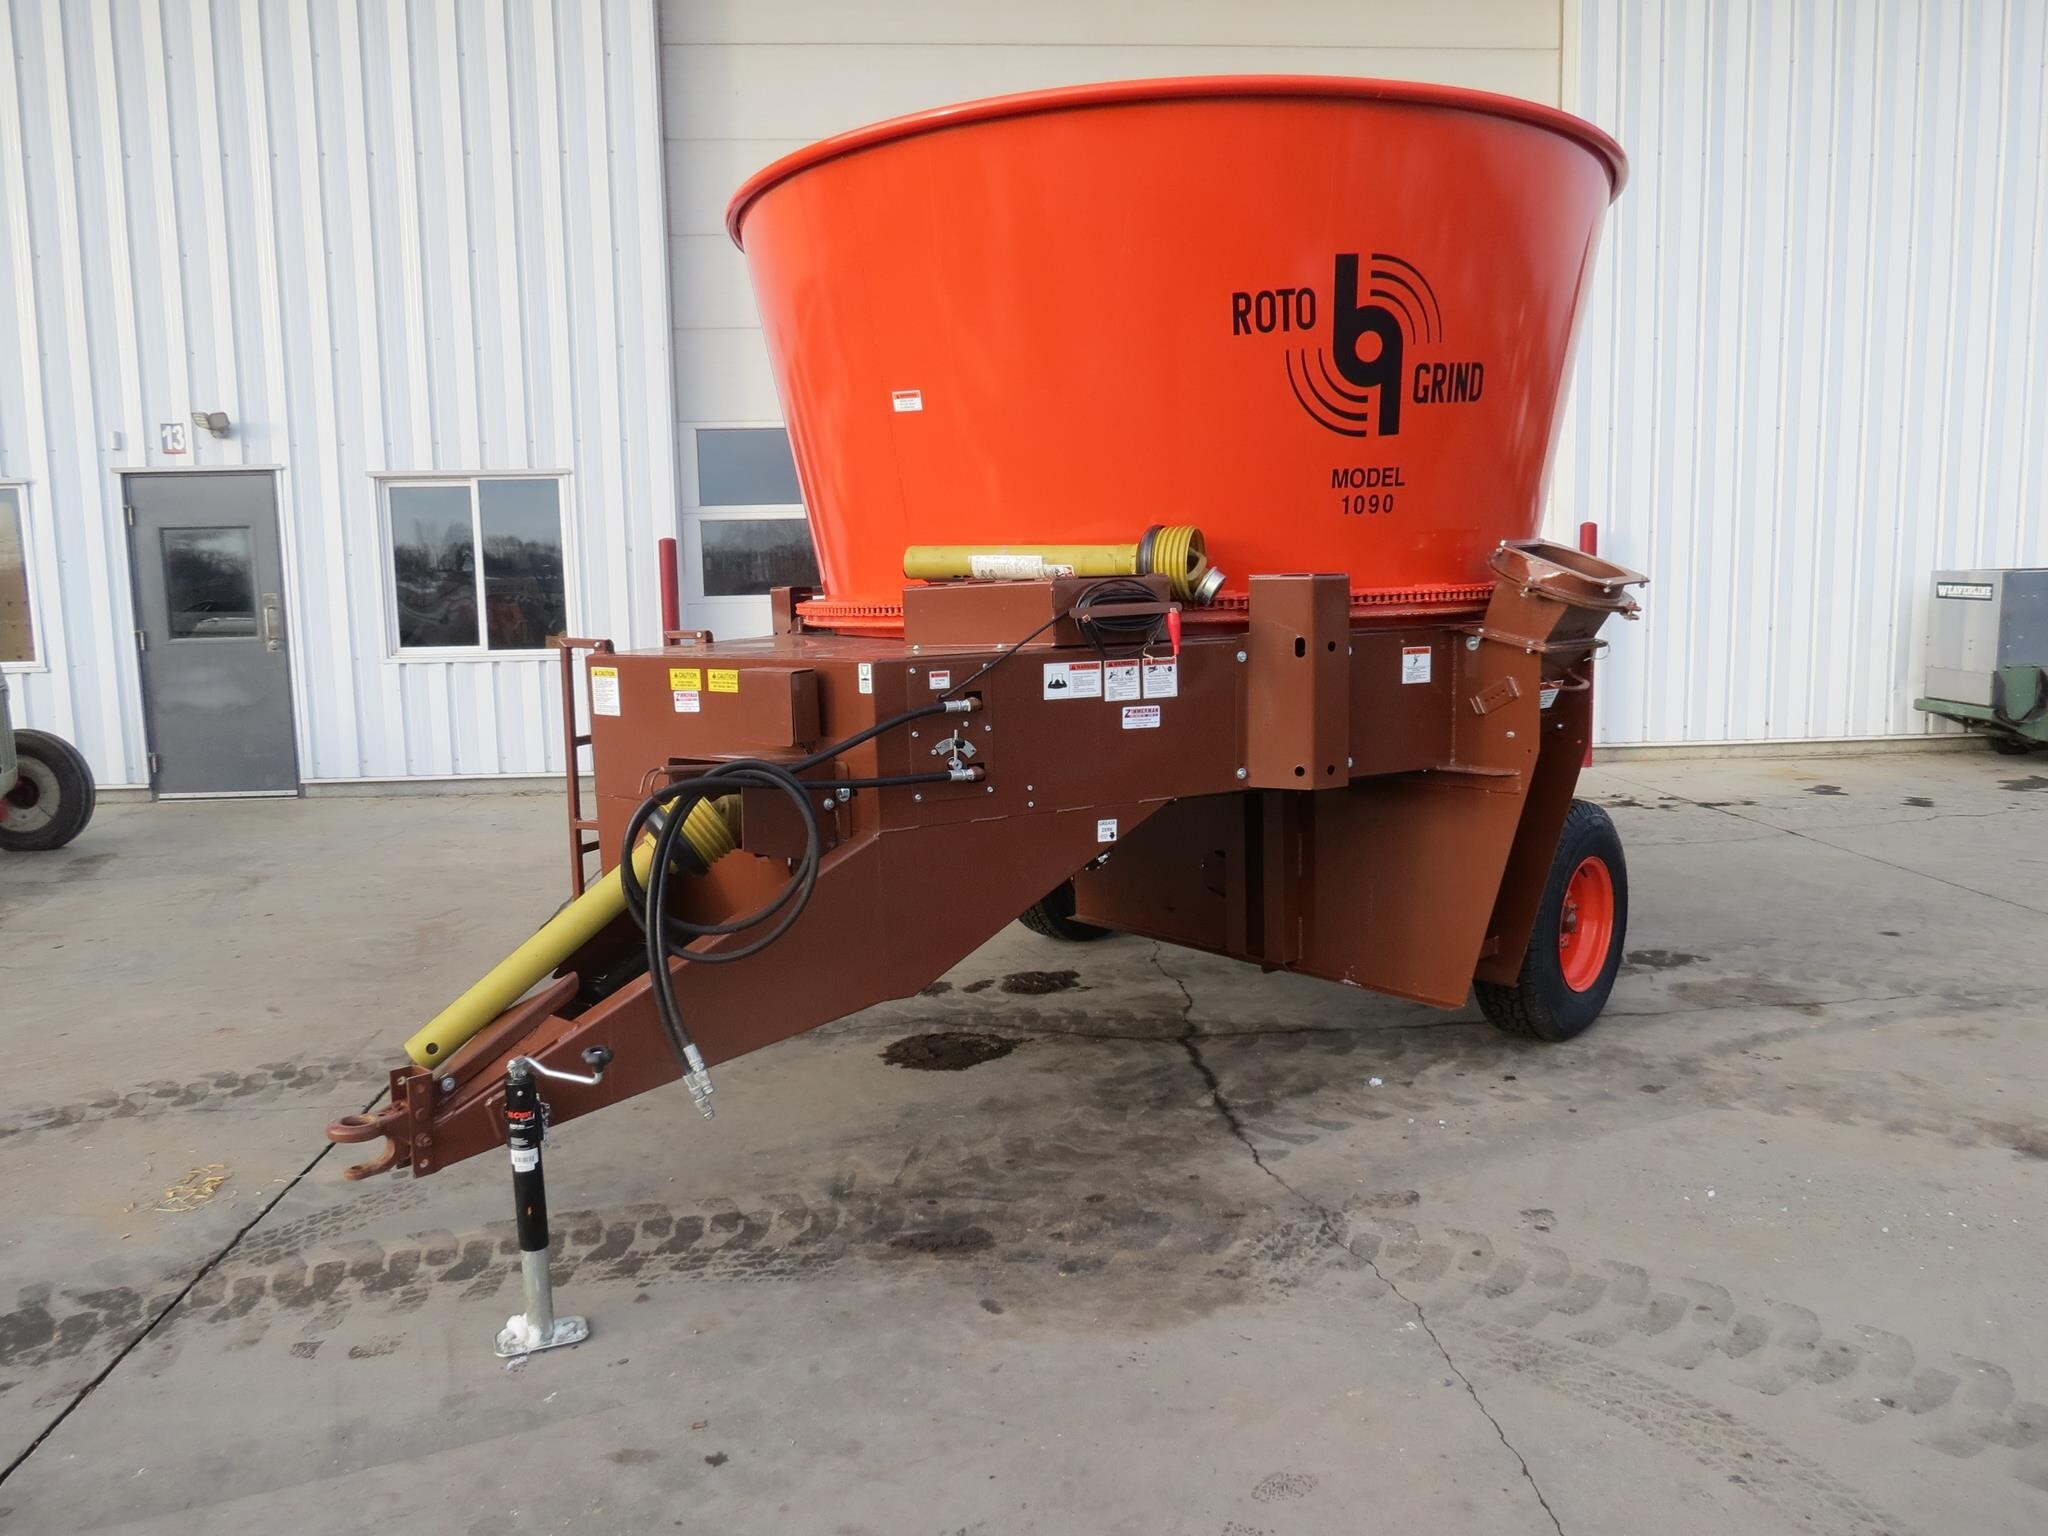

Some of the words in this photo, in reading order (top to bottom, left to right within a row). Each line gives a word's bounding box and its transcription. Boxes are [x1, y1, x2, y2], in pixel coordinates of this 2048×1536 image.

[1232, 287, 1316, 335] ROTO
[1412, 362, 1484, 404] GRIND
[162, 425, 185, 449] 13
[1331, 467, 1405, 489] MODEL
[1341, 494, 1394, 515] 1090
